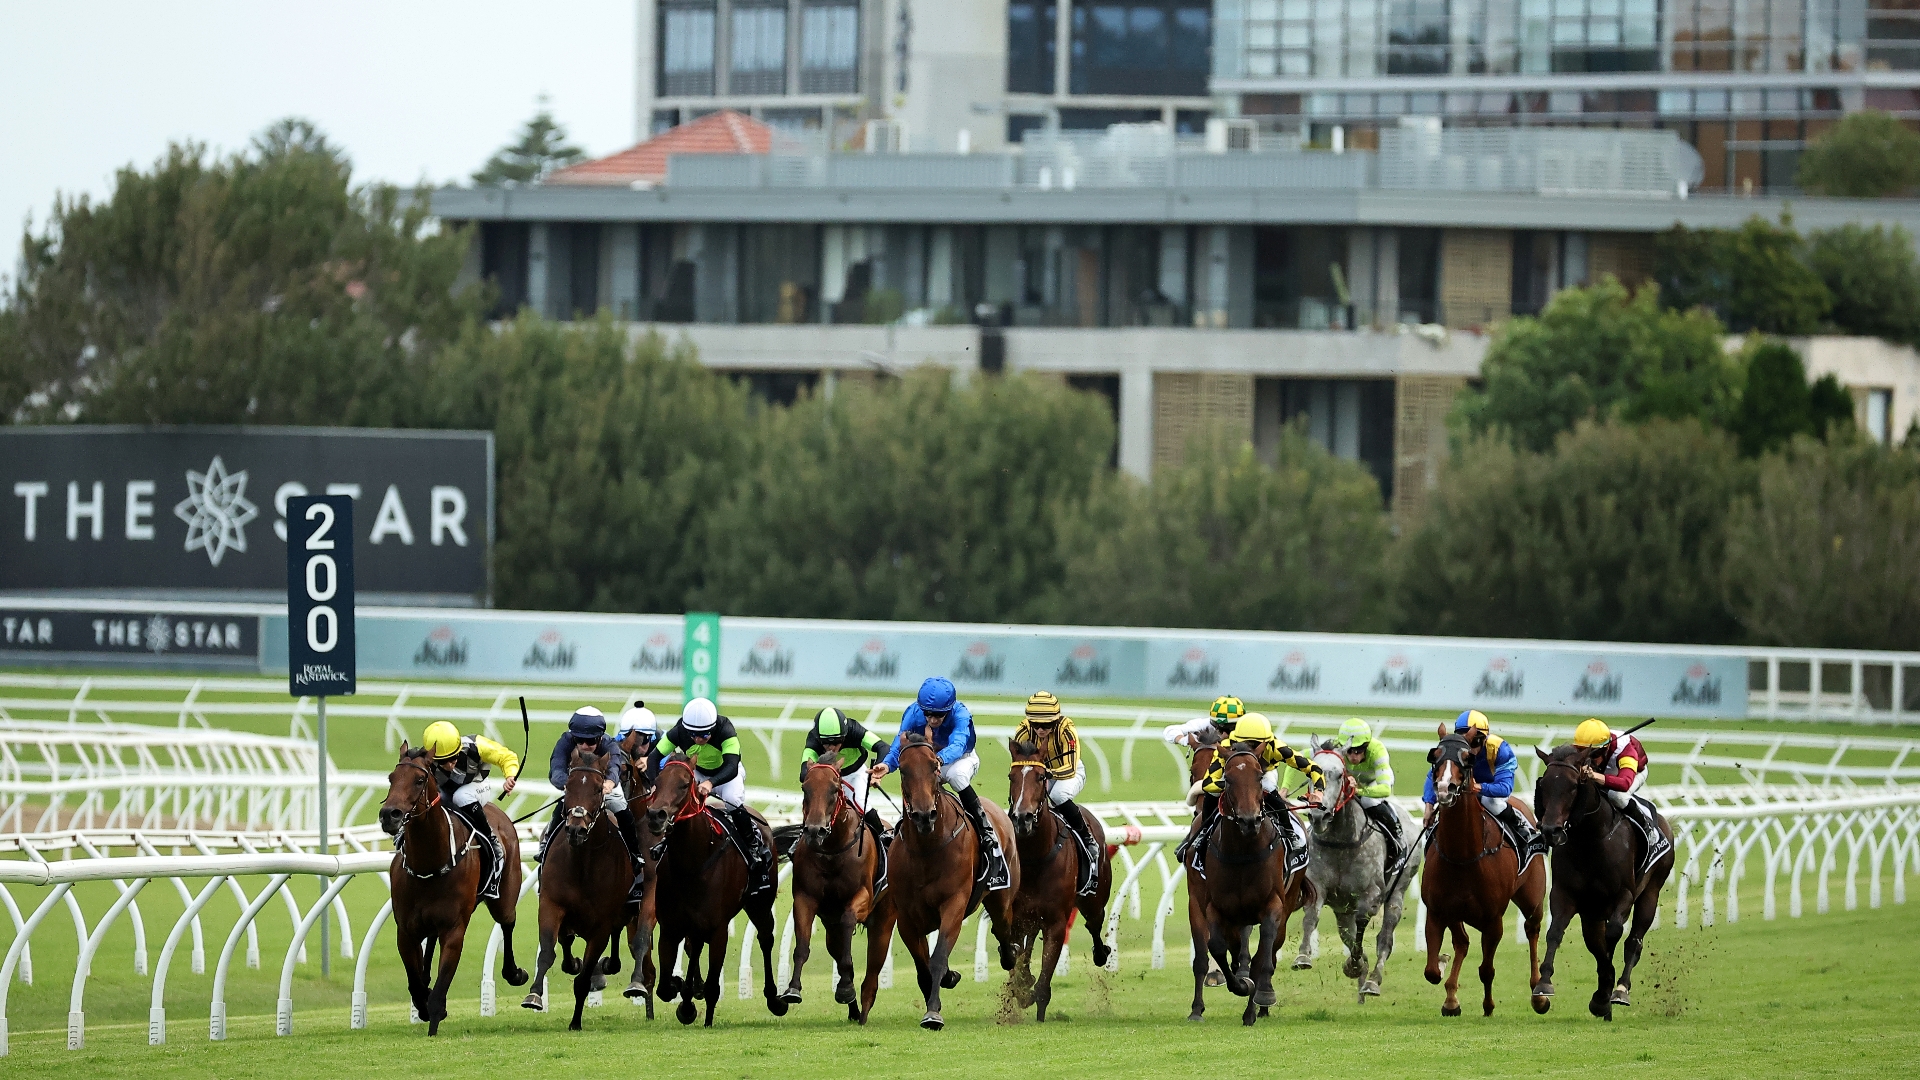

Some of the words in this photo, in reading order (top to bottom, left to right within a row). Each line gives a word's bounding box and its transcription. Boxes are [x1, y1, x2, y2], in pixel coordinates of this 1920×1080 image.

[14, 481, 155, 541] THE
[305, 502, 338, 653] 200
[4, 617, 53, 644] TAR
[92, 620, 141, 647] THE
[175, 621, 241, 650] STAR
[303, 663, 333, 675] ROYAL
[692, 620, 711, 699] 400
[295, 671, 351, 686] RANDWICK
